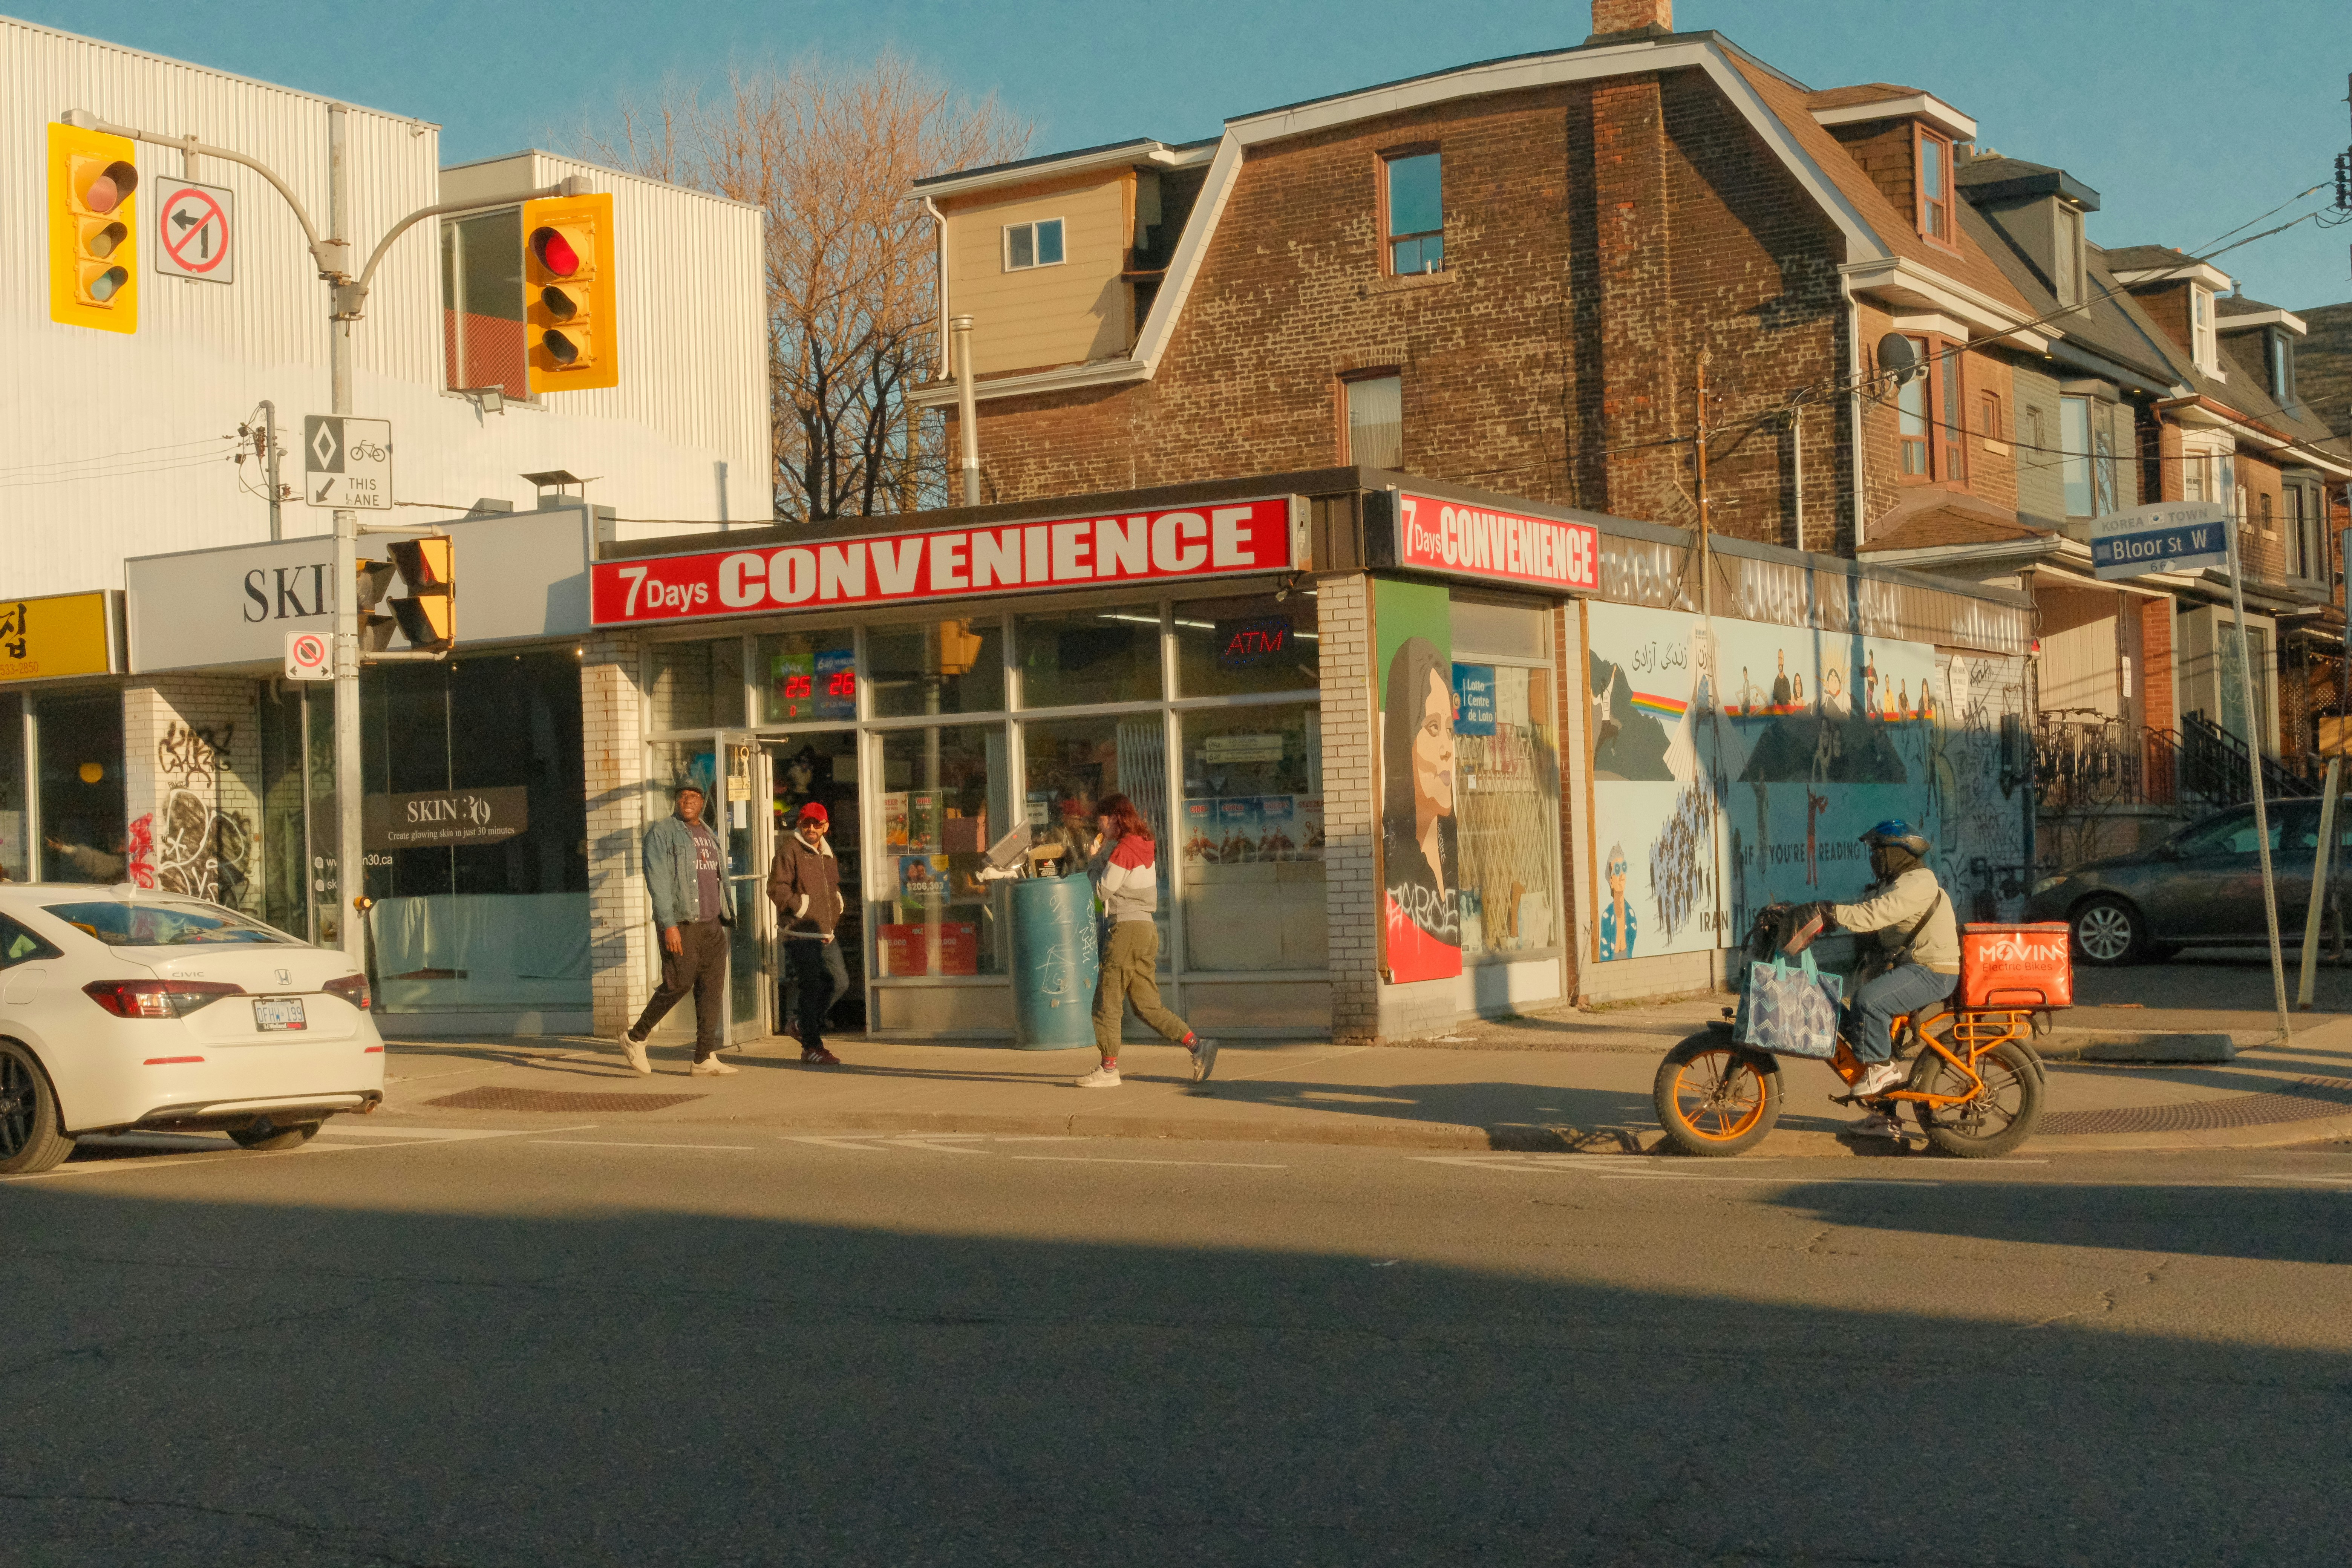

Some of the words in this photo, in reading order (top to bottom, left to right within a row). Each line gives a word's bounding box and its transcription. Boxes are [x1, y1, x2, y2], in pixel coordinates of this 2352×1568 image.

[348, 477, 377, 490] THIS
[346, 493, 380, 506] LANE
[2102, 517, 2144, 532] KOREA
[2168, 508, 2208, 522] TOWN
[1401, 500, 1417, 557] 7
[1415, 524, 1442, 559] Days
[1440, 505, 1592, 584] CONVENIENCE
[2112, 539, 2162, 560] Bloor
[2168, 536, 2183, 553] St
[2191, 529, 2207, 549] W
[619, 566, 647, 616] 7
[647, 580, 709, 612] Days
[718, 507, 1255, 608] CONVENIENCE
[243, 564, 334, 623] SKI
[1225, 630, 1283, 656] ATM
[1631, 641, 1657, 674] آزادی
[1661, 642, 1687, 670] زندگی
[786, 675, 811, 698] 25
[830, 672, 855, 695] 26
[1467, 678, 1485, 691] Lotto
[1467, 694, 1490, 707] Centre
[1468, 709, 1477, 721] de
[1478, 710, 1493, 722] Loto
[407, 799, 457, 822] SKIN
[388, 831, 409, 840] Create
[411, 829, 438, 841] glowing
[439, 828, 453, 838] skin
[455, 828, 462, 837] in
[463, 827, 476, 839] just
[477, 827, 486, 836] 30
[488, 826, 515, 835] minutes
[1744, 844, 1753, 865] IF
[1770, 842, 1806, 865] YOU'RE
[1818, 841, 1859, 862] READING
[1980, 940, 2056, 962] MOVIN
[1983, 963, 2021, 972] Electric
[2024, 961, 2053, 971] Bikes
